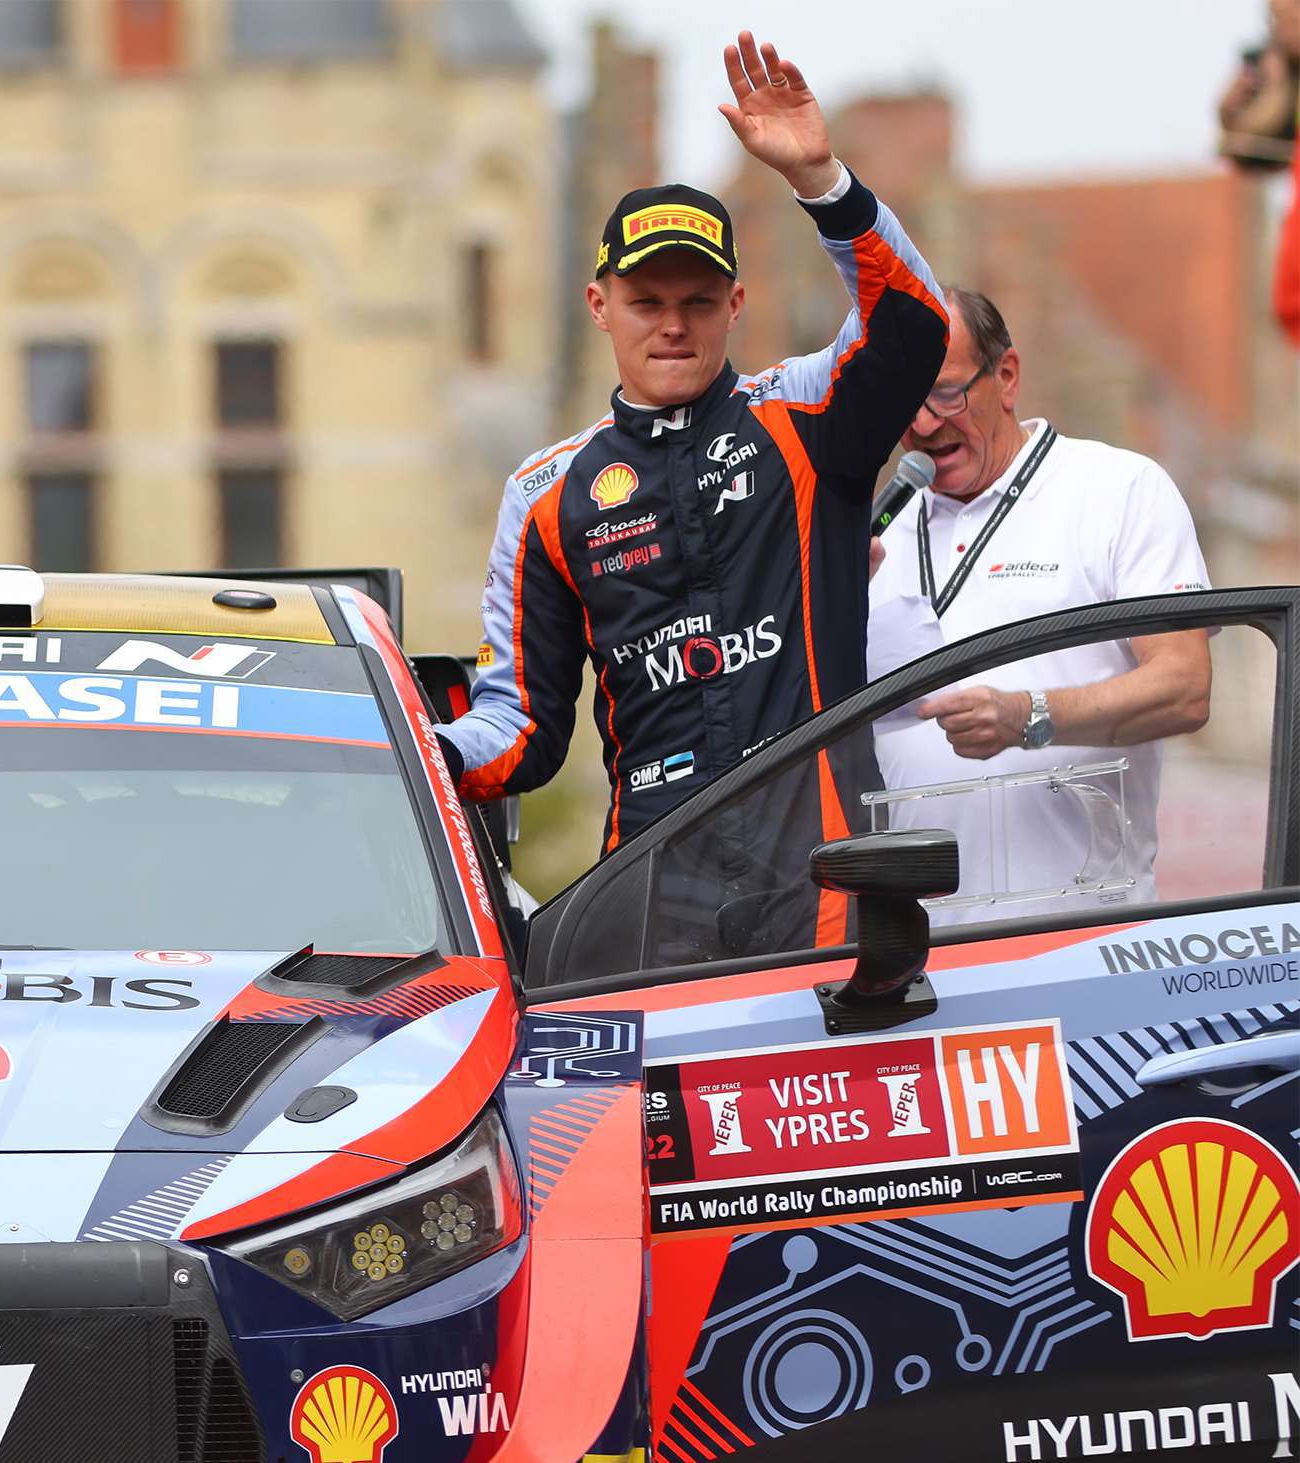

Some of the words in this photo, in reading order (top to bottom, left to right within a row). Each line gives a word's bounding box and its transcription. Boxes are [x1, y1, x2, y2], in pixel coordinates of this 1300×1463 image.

[629, 210, 717, 240] PIRELLI
[523, 463, 559, 492] OMP
[585, 512, 657, 539] Grossi
[602, 546, 649, 574] redgrey
[1005, 560, 1059, 571] ardeca
[613, 614, 712, 665] HYUNDAI
[645, 615, 782, 691] MOBIS
[630, 764, 661, 786] OMP
[416, 711, 494, 921] motorsport.hyundai.com
[1098, 923, 1300, 974] INNOCEA
[1162, 960, 1299, 995] WORLDWIDE
[697, 1085, 711, 1093] CITY
[722, 1082, 741, 1090] PEACE
[877, 1066, 890, 1074] CITY
[900, 1064, 920, 1072] PEACE
[768, 1071, 850, 1109] VISIT
[893, 1082, 916, 1127] IEPER
[957, 1043, 1040, 1139] HY
[715, 1100, 737, 1146] IEPER
[765, 1109, 870, 1149] YPRES
[661, 1204, 695, 1224] FIA
[699, 1199, 758, 1219] World
[765, 1191, 815, 1213] Rally
[821, 1175, 963, 1207] Championship
[401, 1368, 482, 1394] HYUNDAI
[1003, 1401, 1252, 1462] HYUNDAI
